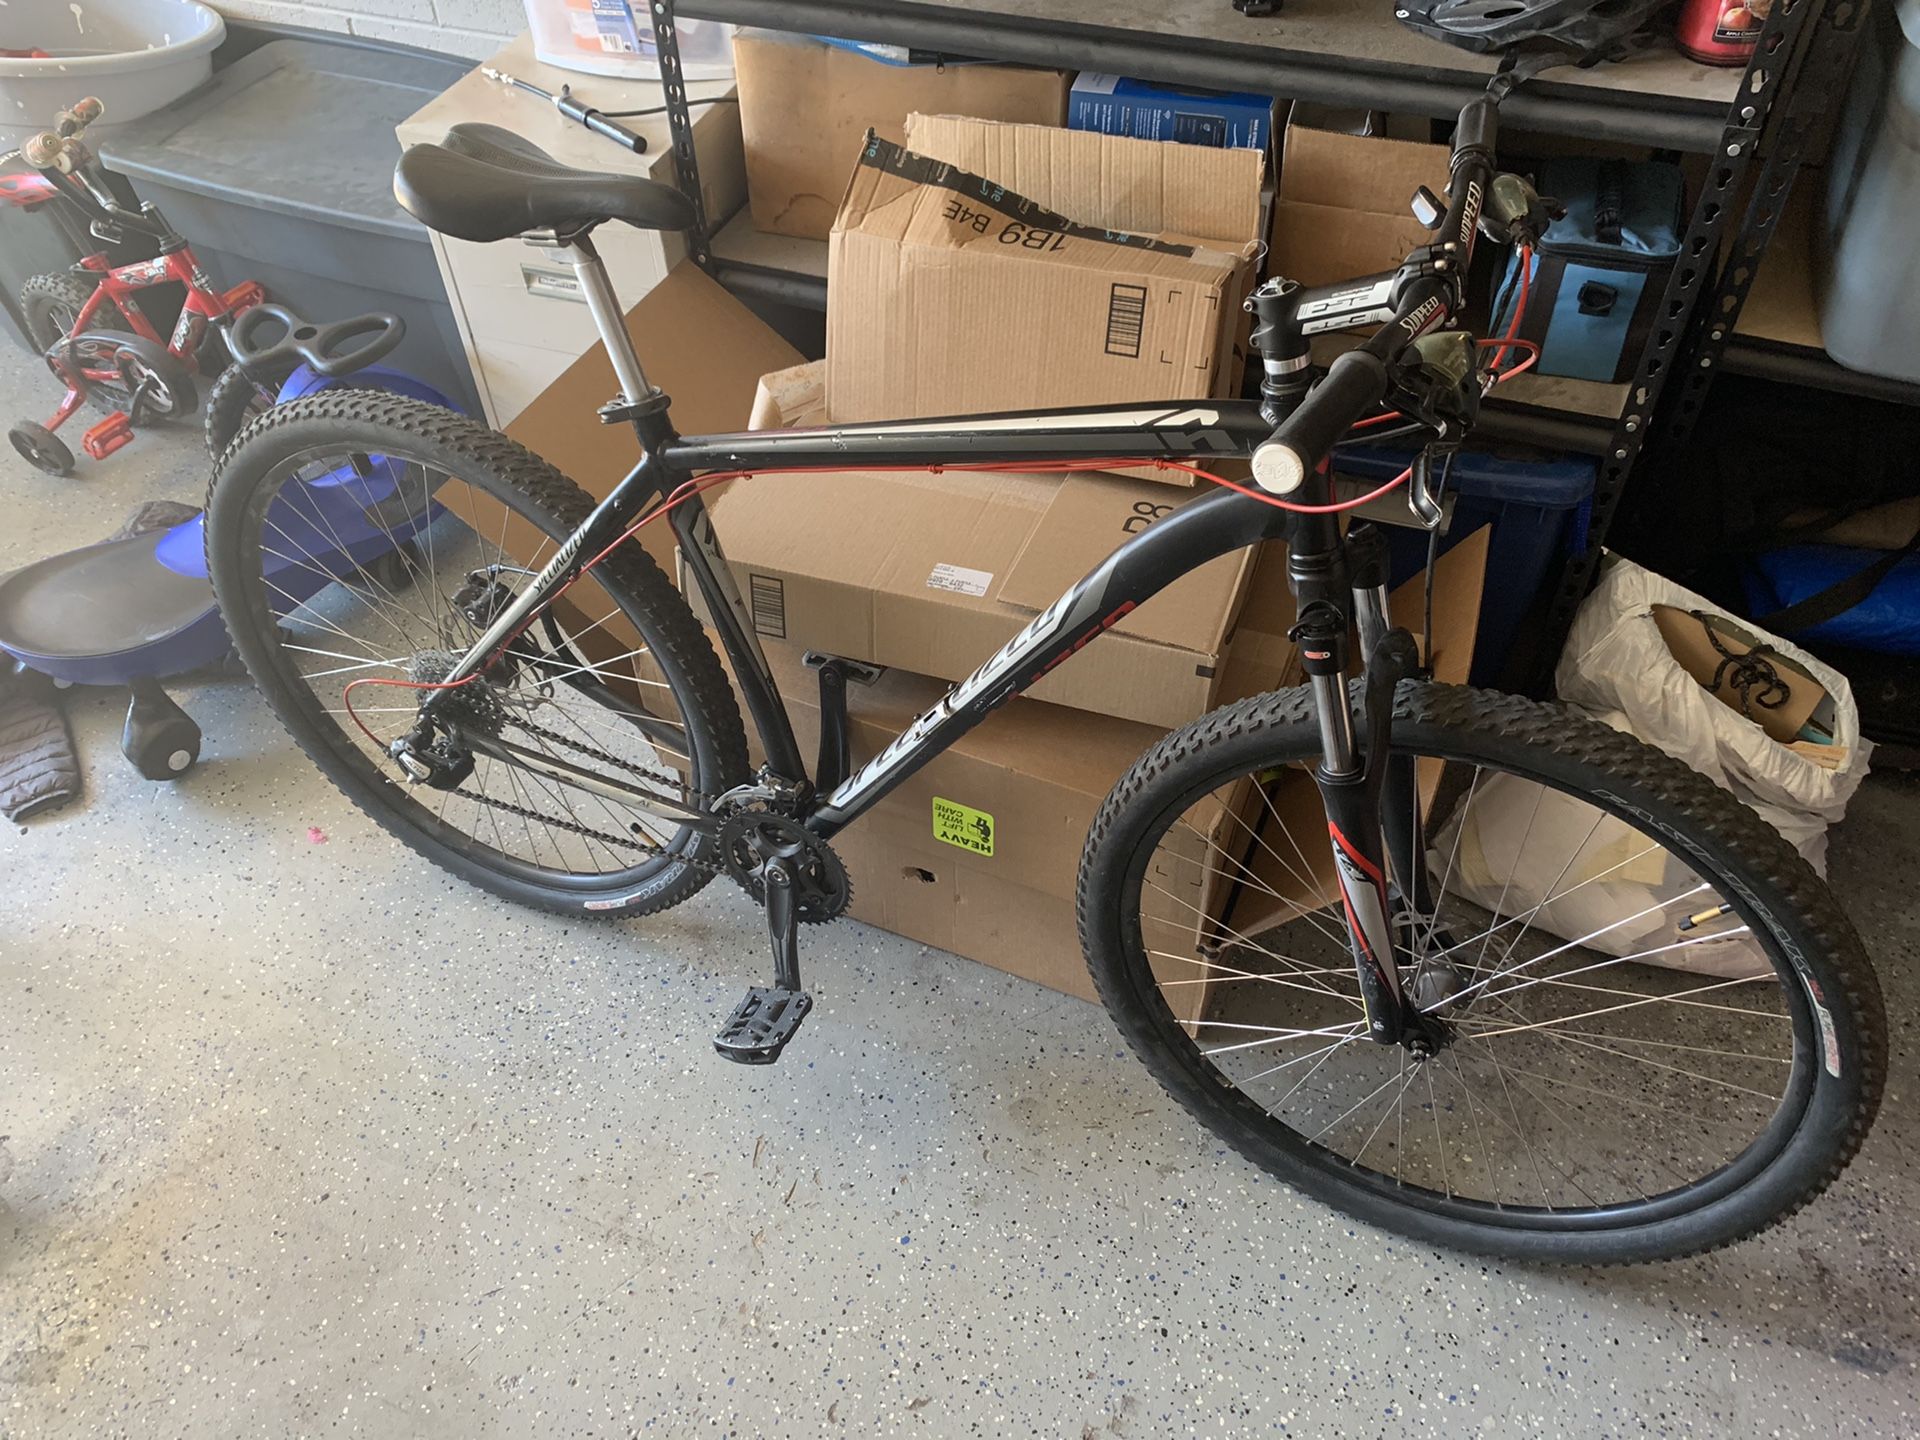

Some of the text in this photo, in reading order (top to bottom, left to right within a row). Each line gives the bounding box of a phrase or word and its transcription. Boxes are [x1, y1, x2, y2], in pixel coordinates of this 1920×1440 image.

[942, 200, 1066, 253] 1B9 B4E
[1460, 181, 1482, 243] SUNPEED
[1399, 296, 1440, 339] SUNPEED
[533, 529, 586, 595] SPECIALIZED
[934, 804, 963, 818] CARE
[938, 812, 963, 826] WITH
[941, 820, 963, 832] LIFT
[939, 830, 991, 854] HEAVY
